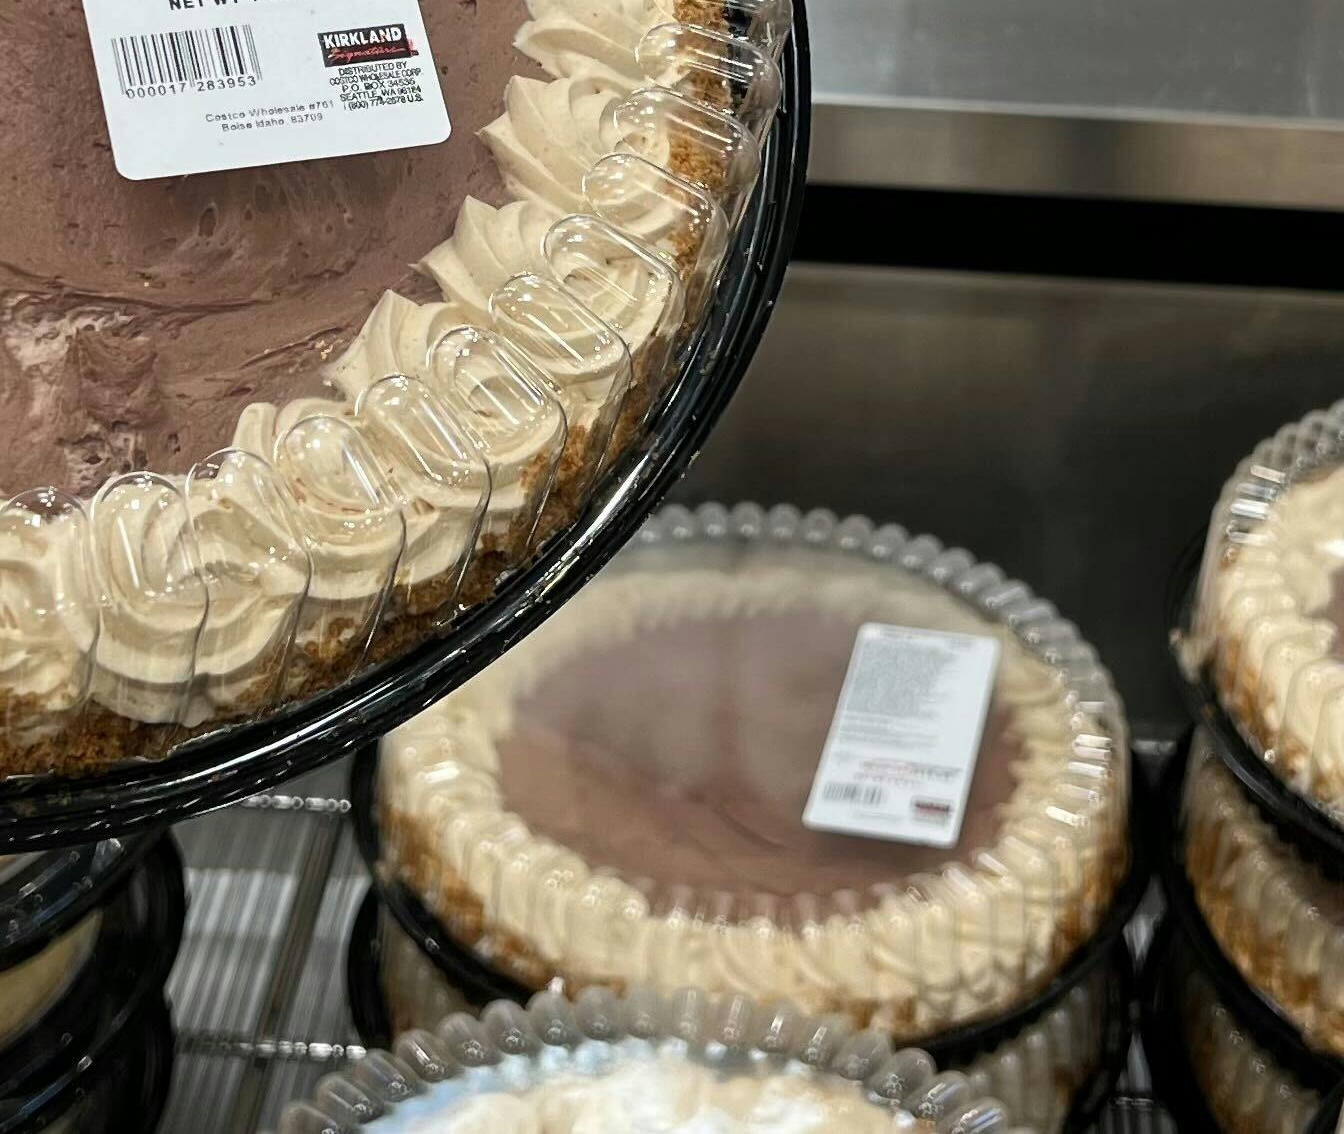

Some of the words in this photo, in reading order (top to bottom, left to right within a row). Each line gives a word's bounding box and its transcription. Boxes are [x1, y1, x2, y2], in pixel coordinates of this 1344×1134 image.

[321, 26, 403, 48] KIRKLAND
[337, 63, 394, 75] DISTRIBUTED
[328, 75, 359, 85] COSTCO
[358, 70, 401, 81] WHOLESALE
[125, 83, 187, 99] 000017
[195, 75, 257, 91] 283953
[363, 81, 386, 89] BOX
[380, 88, 396, 96] WA
[204, 110, 246, 122] Costco
[248, 103, 306, 117] Wholesale
[221, 121, 253, 131] Boise
